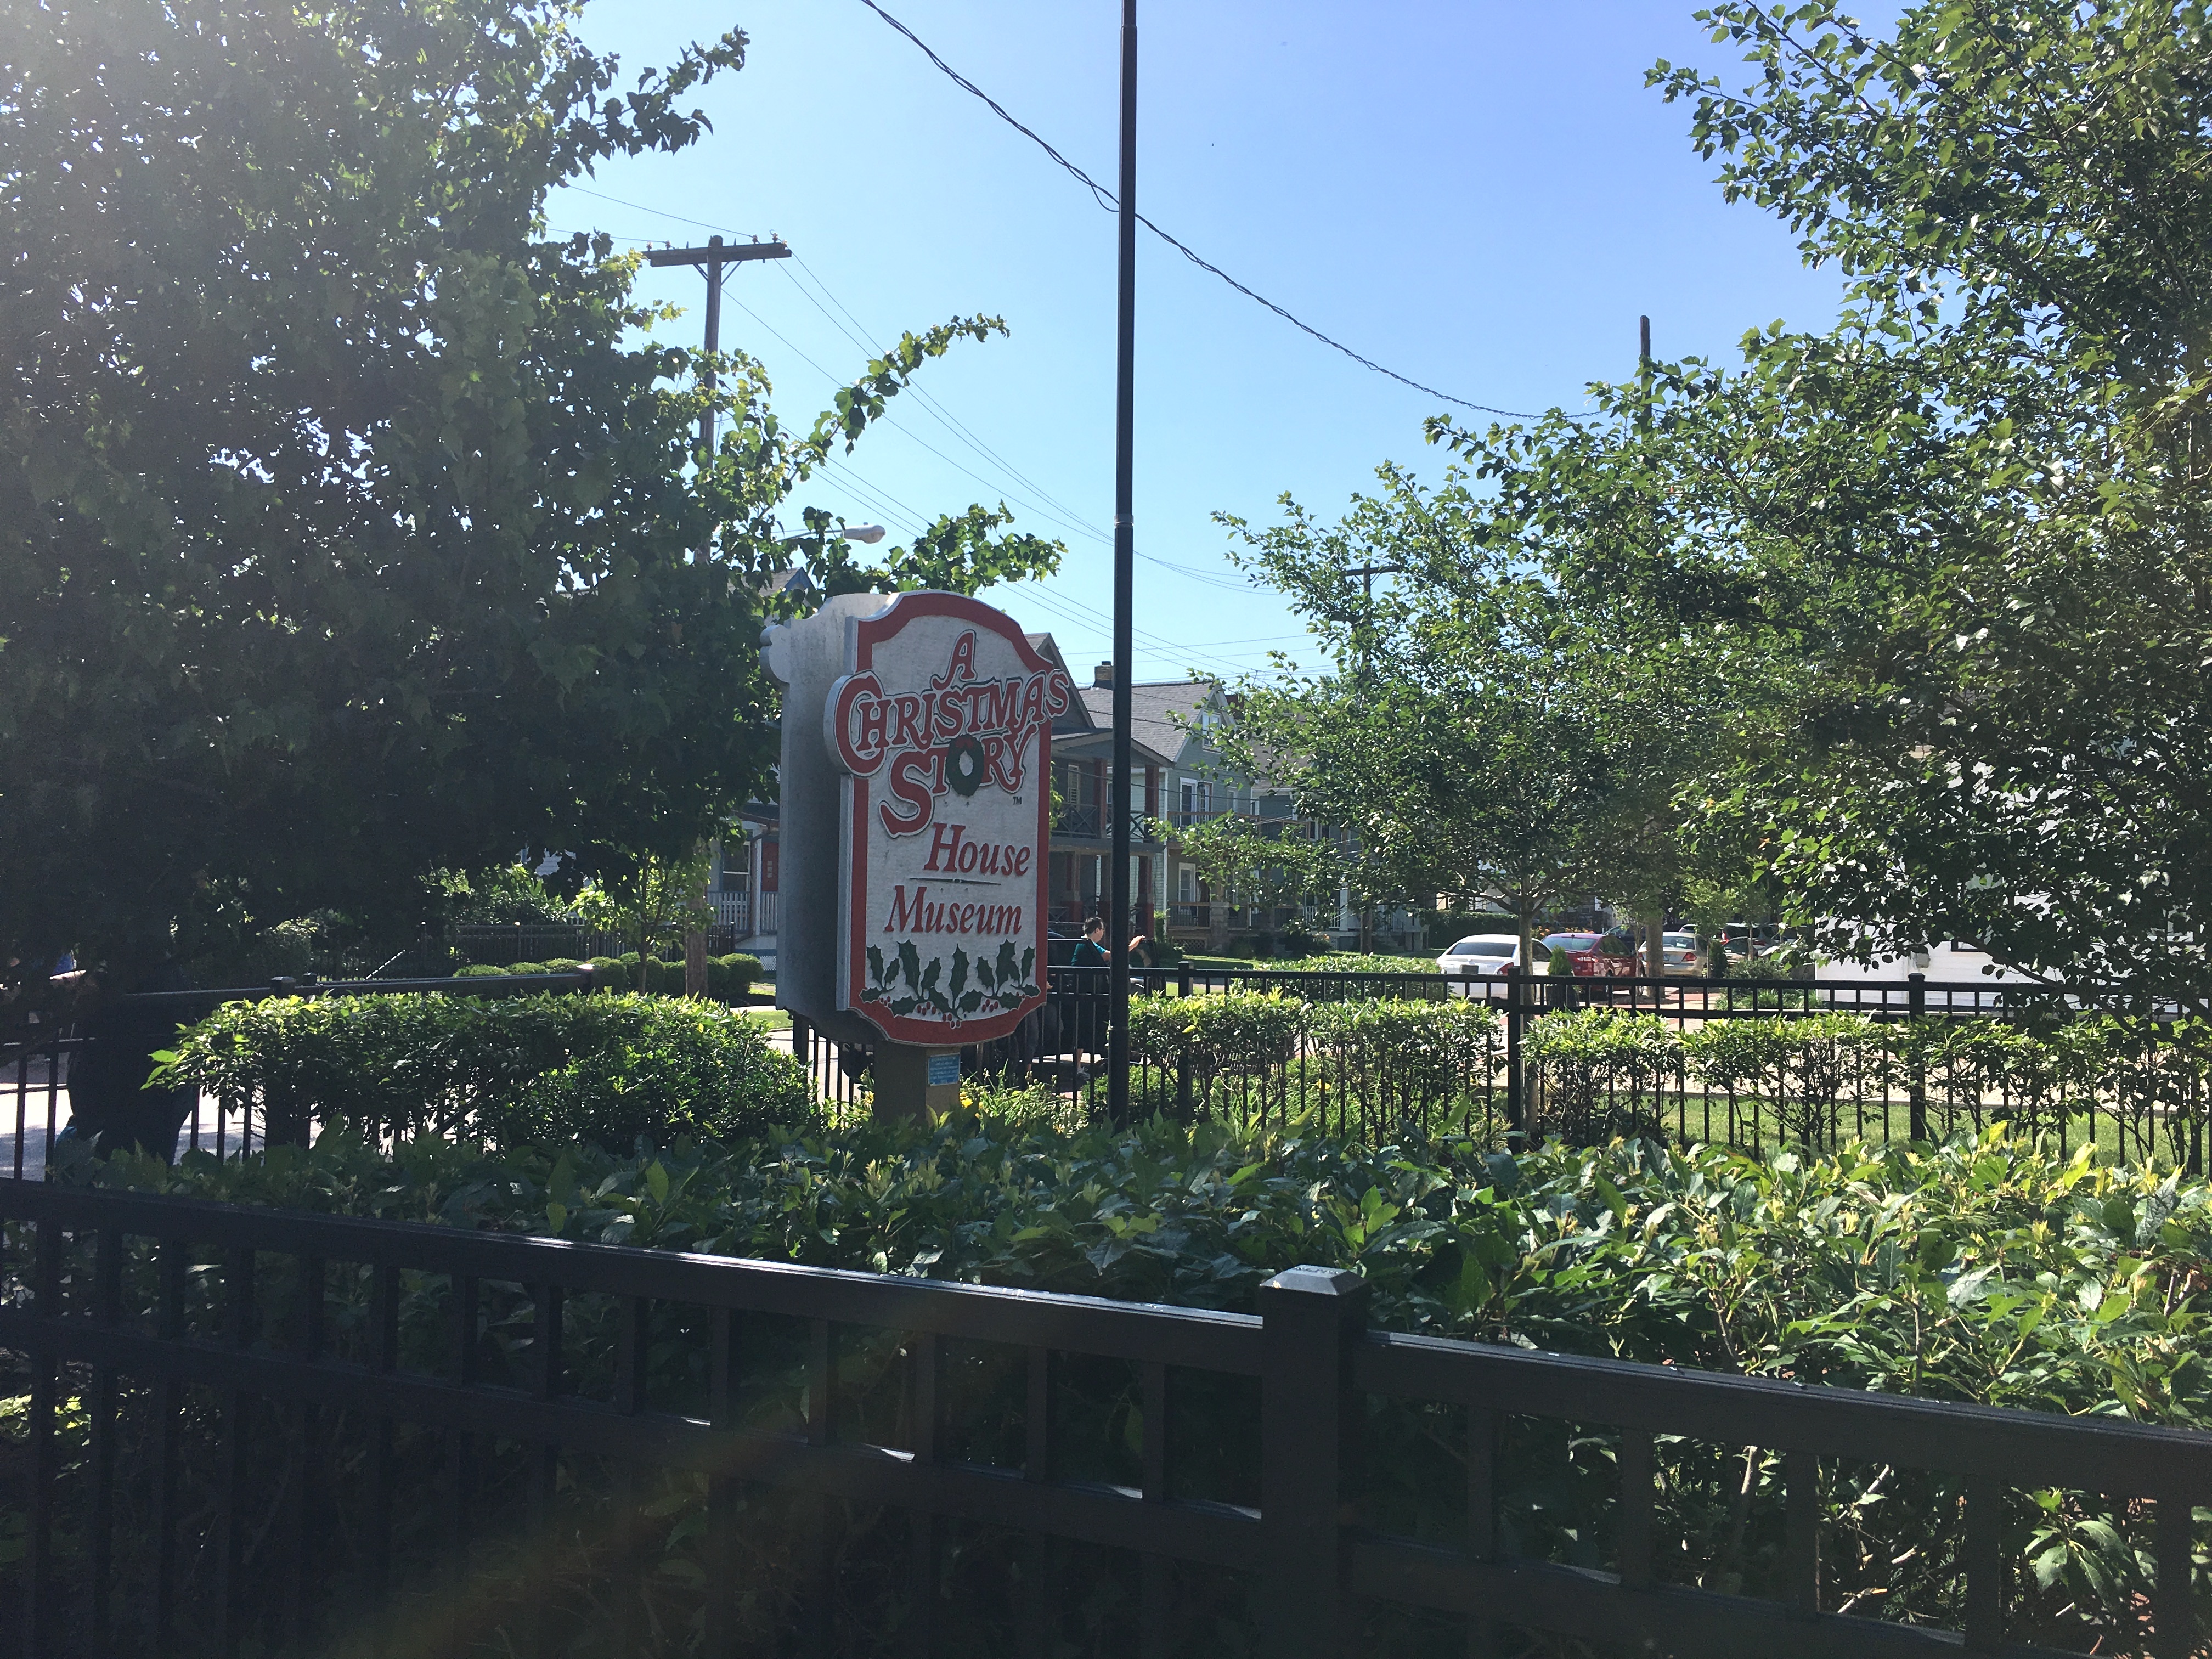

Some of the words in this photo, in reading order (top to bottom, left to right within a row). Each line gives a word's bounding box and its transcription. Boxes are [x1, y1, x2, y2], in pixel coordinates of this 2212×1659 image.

[932, 630, 977, 690] A
[835, 672, 1069, 775] CHRISTMAS
[879, 723, 1039, 836] STORY
[923, 822, 1030, 876] House
[884, 885, 1022, 934] Museum
